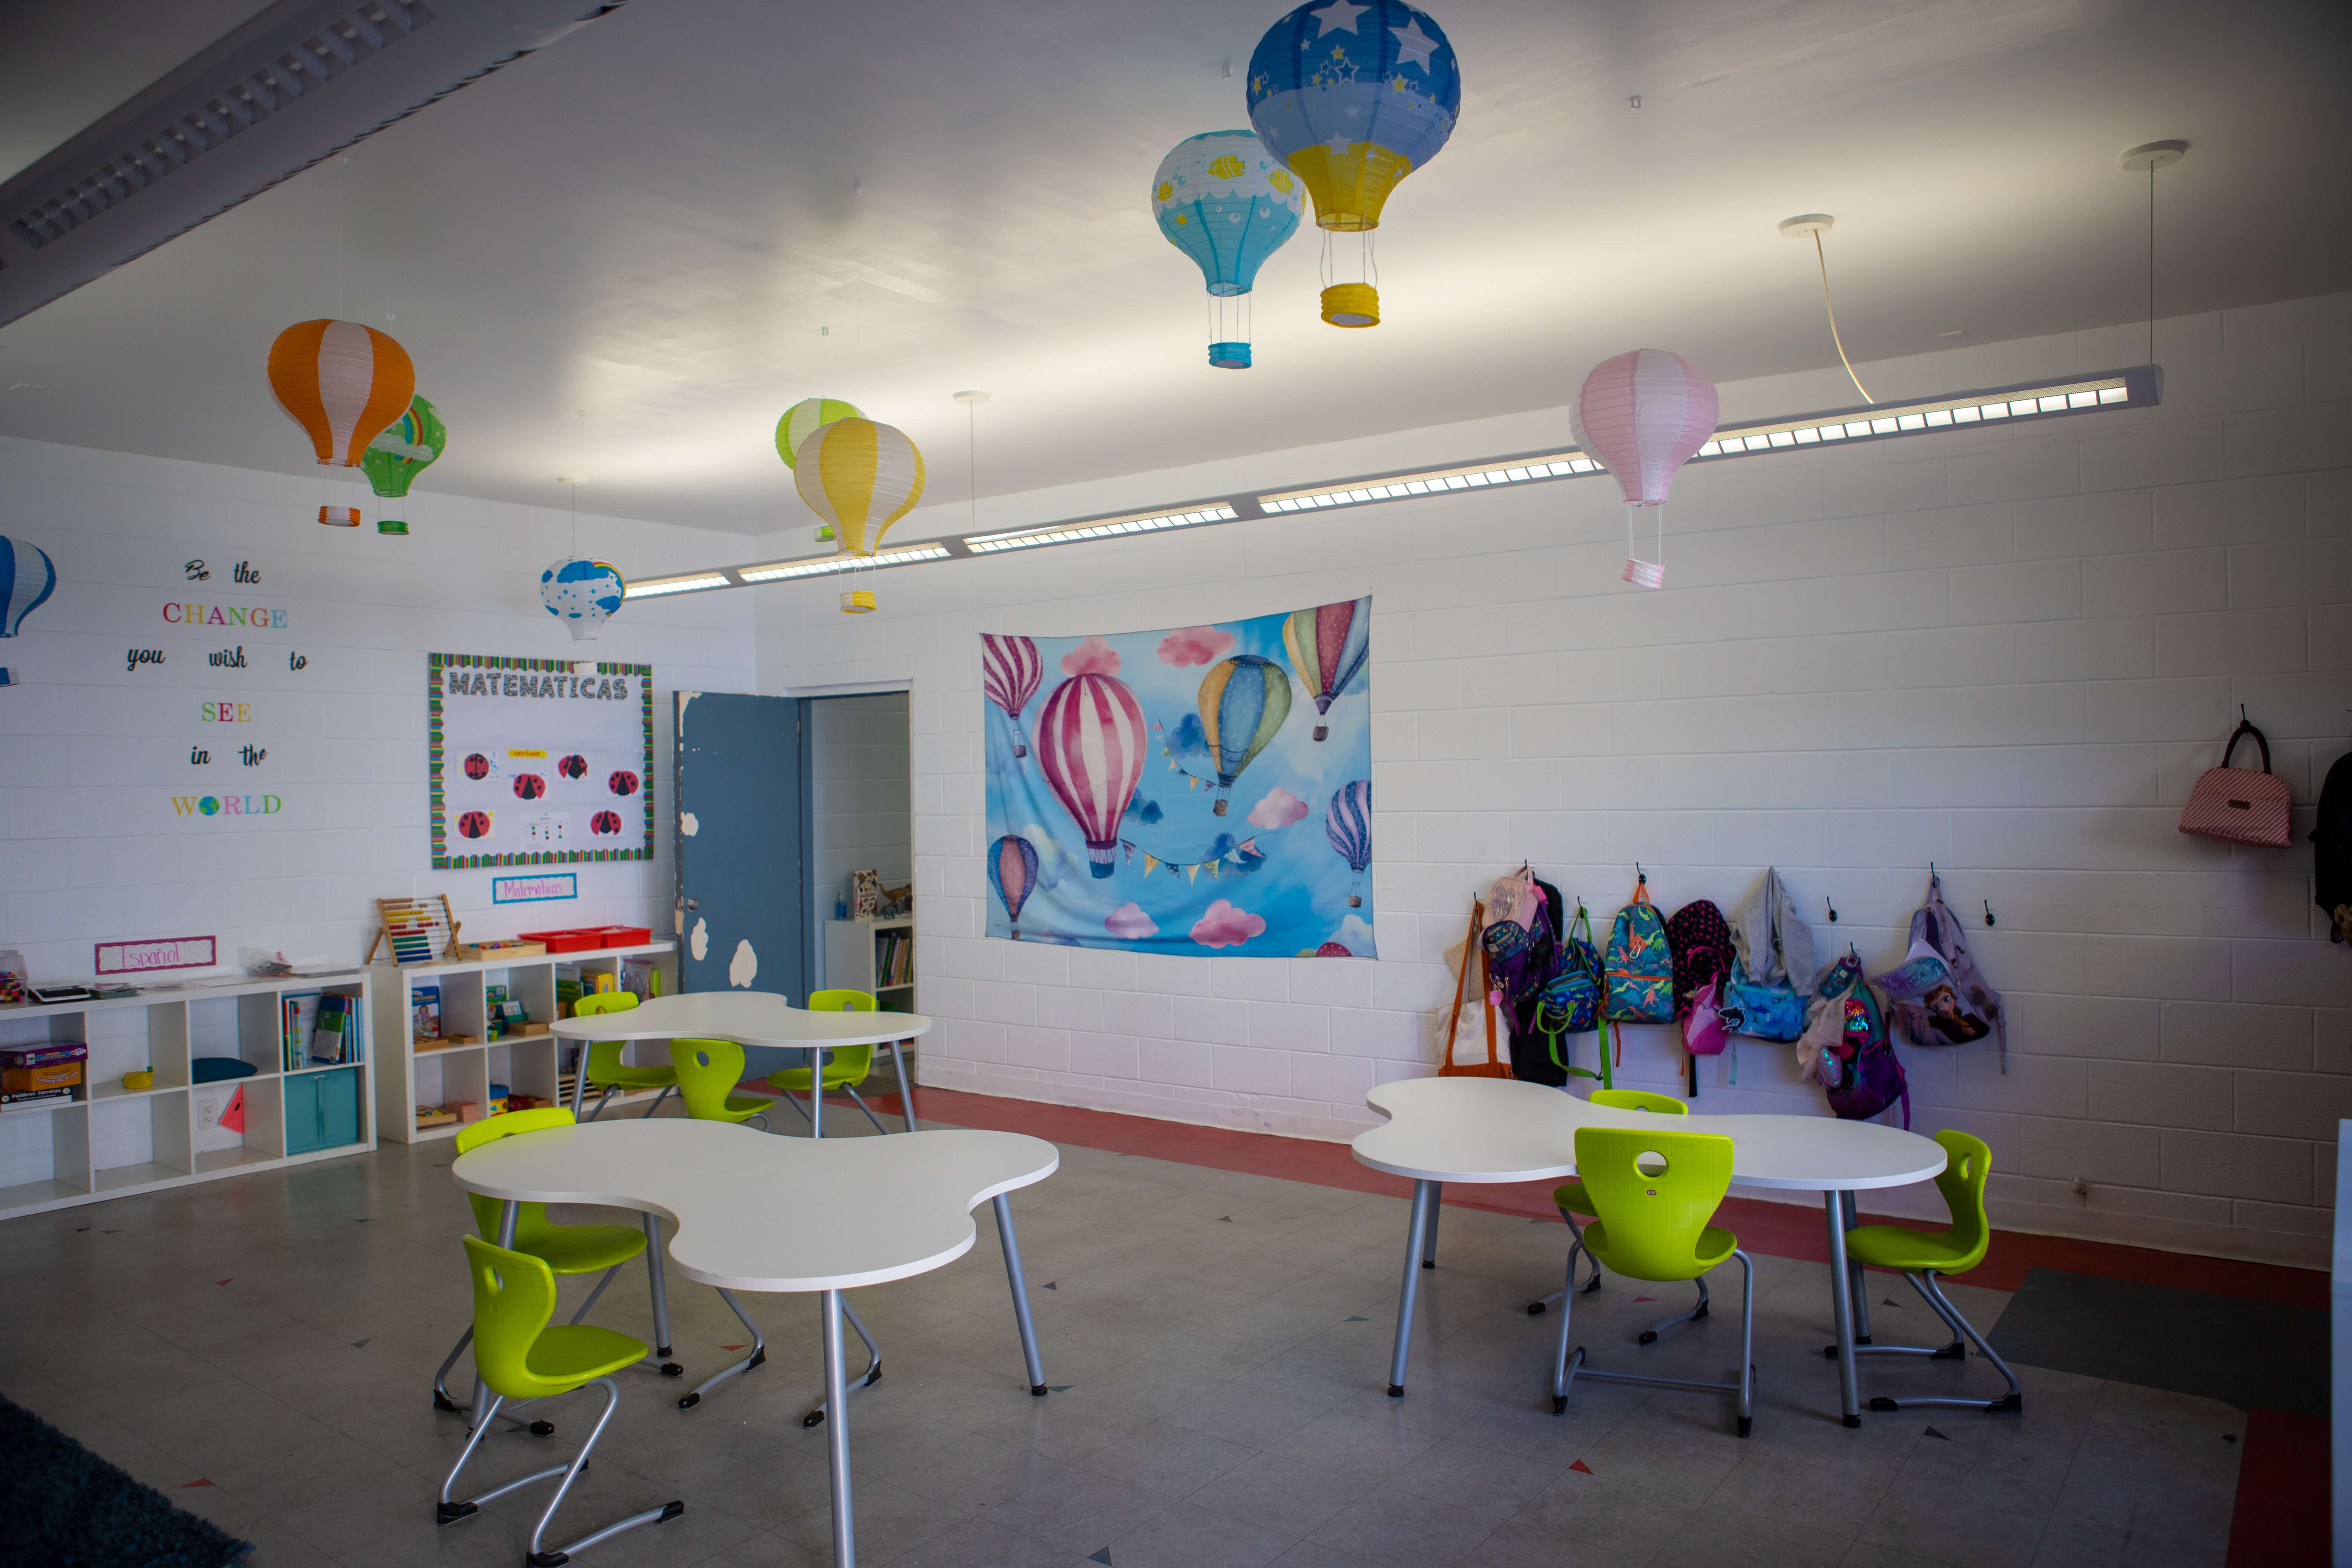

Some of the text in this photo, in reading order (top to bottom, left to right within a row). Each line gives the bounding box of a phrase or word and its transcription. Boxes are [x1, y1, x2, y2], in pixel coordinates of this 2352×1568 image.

[185, 560, 261, 583] Be the
[163, 603, 288, 628] CHANGE
[127, 646, 308, 671] you wish to
[449, 672, 628, 700] MATEMATICAS
[202, 701, 252, 722] SEE
[191, 744, 268, 767] in the
[122, 943, 179, 967] Español
